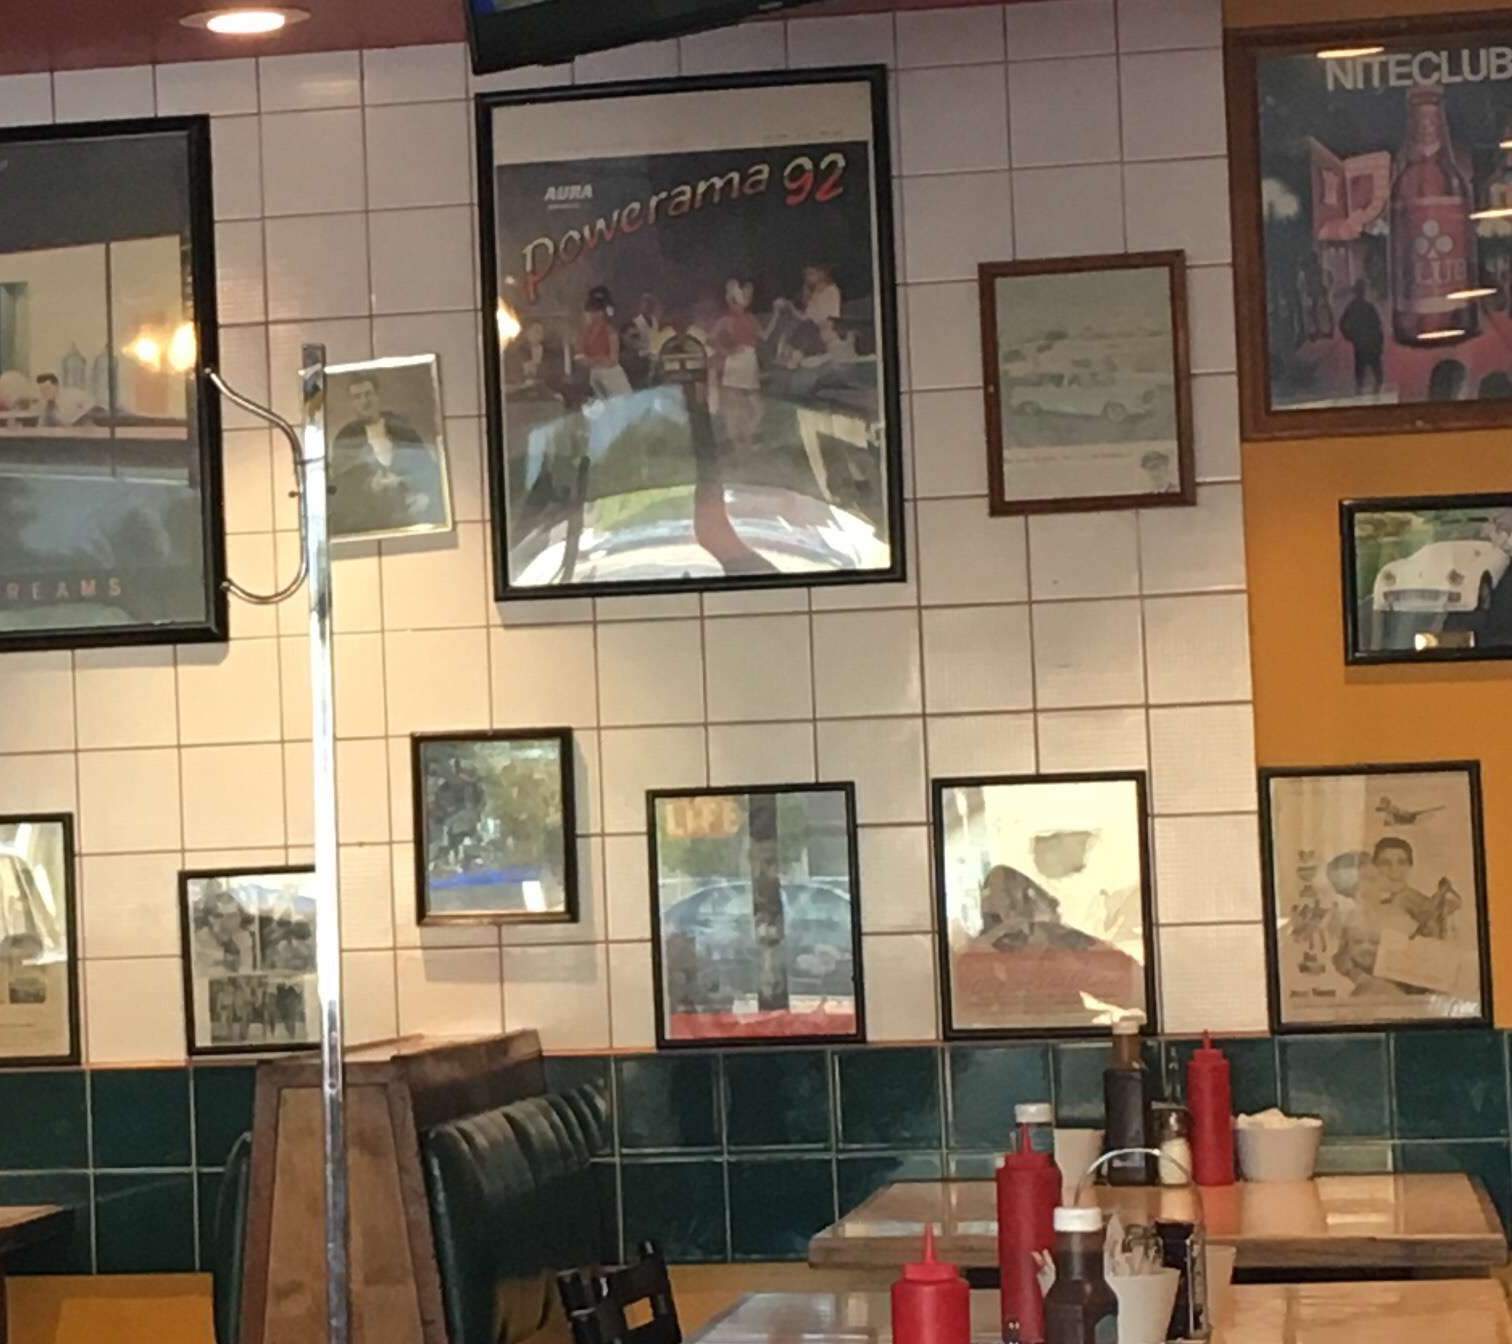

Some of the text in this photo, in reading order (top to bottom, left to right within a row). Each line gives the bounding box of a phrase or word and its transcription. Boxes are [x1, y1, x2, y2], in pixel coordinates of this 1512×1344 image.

[1325, 46, 1512, 91] NITECLUB
[521, 151, 846, 302] Powerama 92
